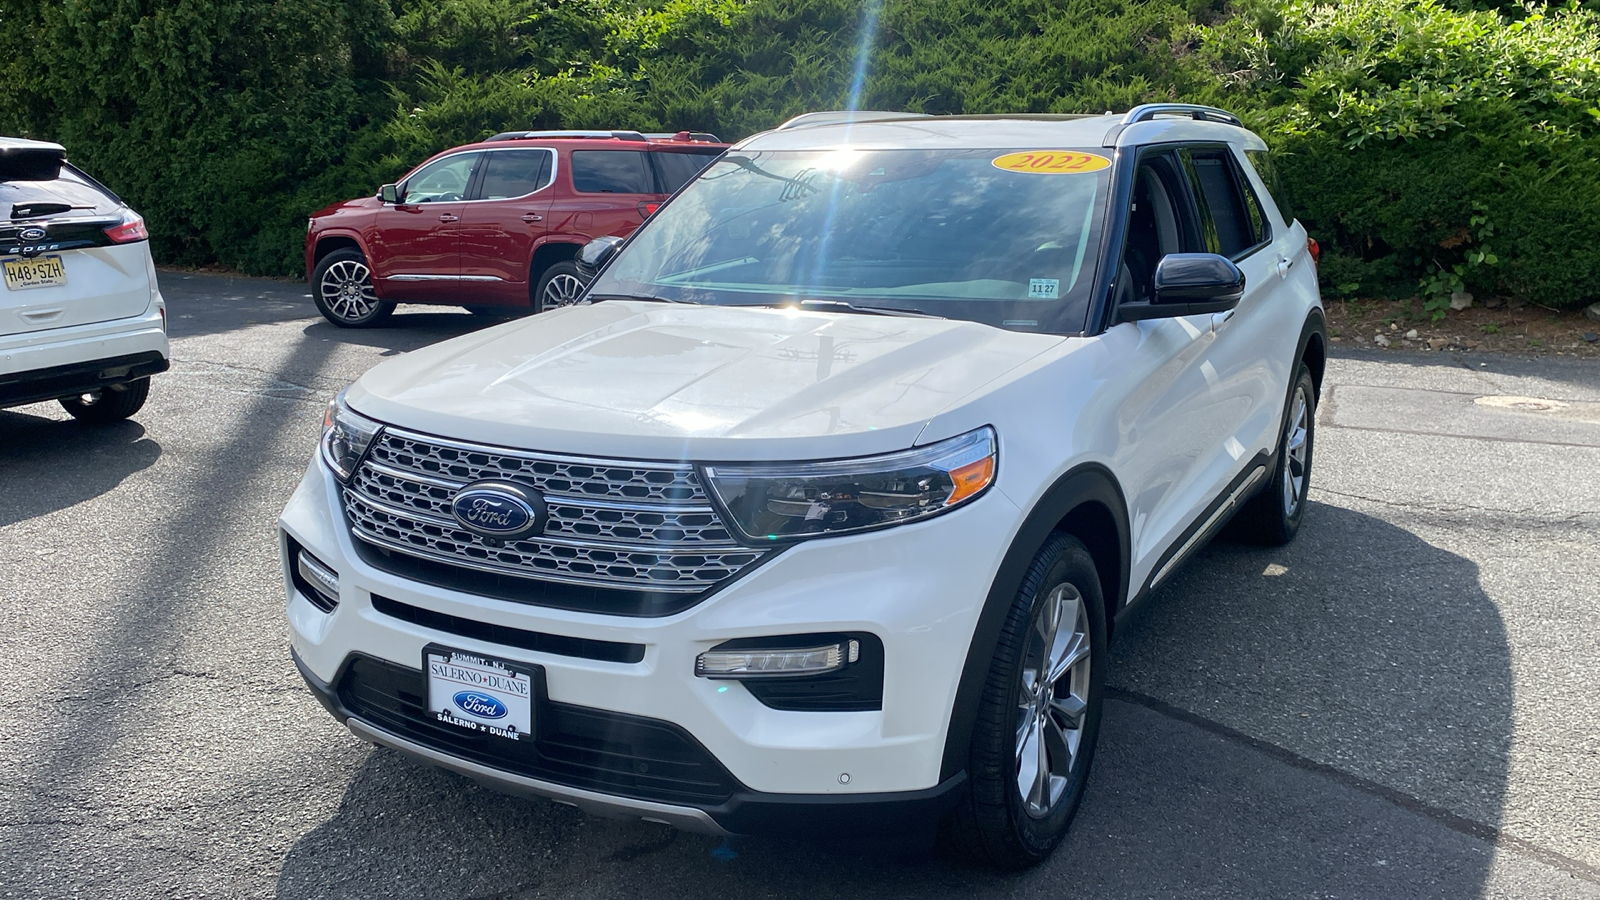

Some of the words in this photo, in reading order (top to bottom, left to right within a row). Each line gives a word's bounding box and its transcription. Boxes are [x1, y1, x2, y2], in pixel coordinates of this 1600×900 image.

[1009, 155, 1092, 169] 2022
[9, 244, 59, 253] EDGE
[1032, 285, 1042, 293] 11
[1045, 285, 1055, 293] 27
[467, 498, 513, 526] Ford
[451, 652, 489, 666] SUMMIT,
[492, 661, 505, 670] NJ
[431, 664, 482, 684] SALERNO
[488, 675, 528, 695] DUANE
[463, 694, 497, 716] Ford
[437, 713, 477, 730] SALERNO
[489, 726, 519, 741] DUANE
